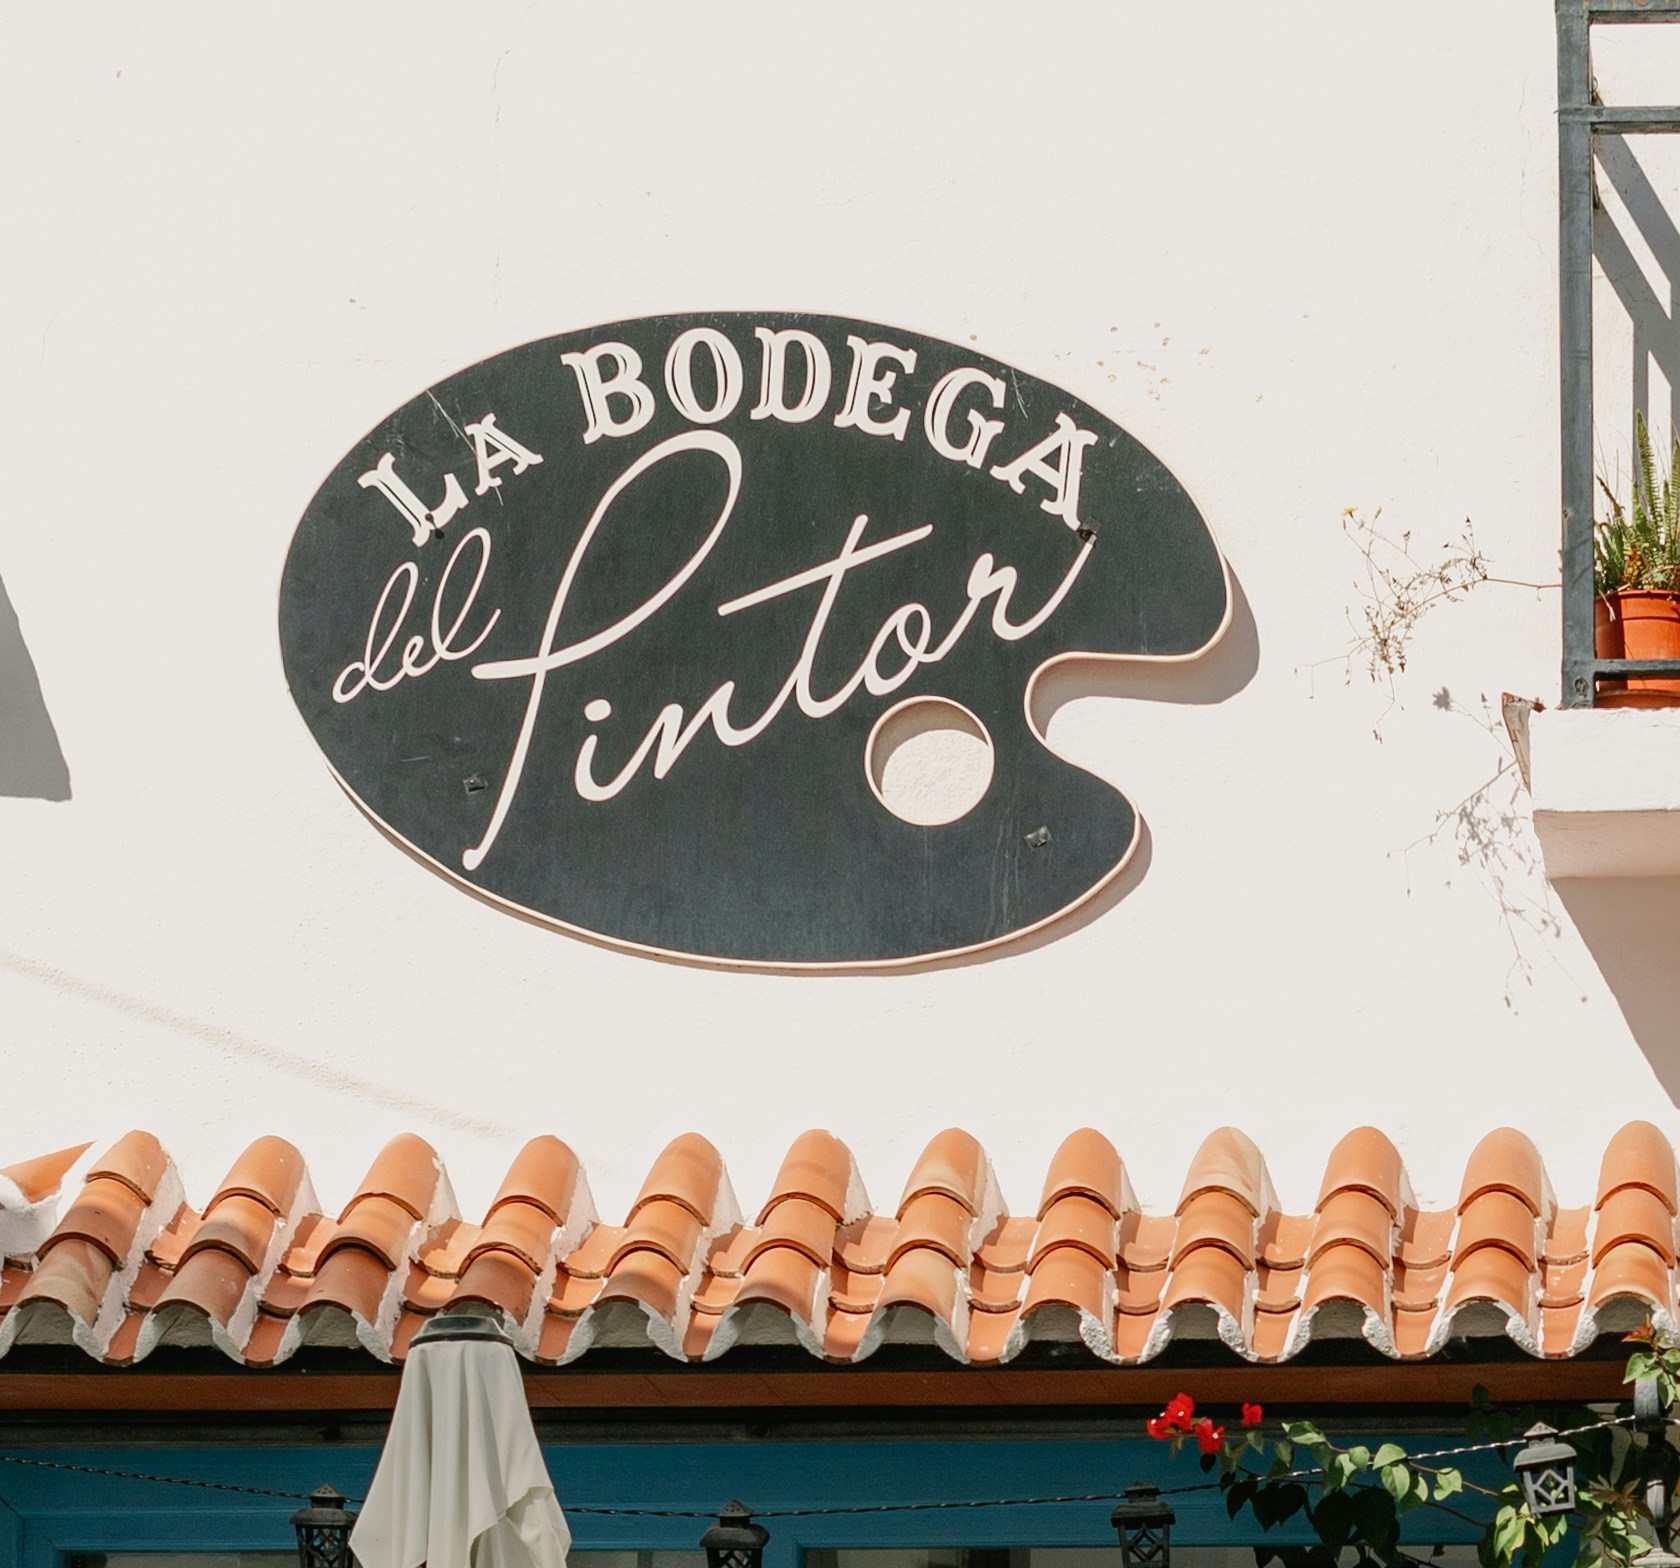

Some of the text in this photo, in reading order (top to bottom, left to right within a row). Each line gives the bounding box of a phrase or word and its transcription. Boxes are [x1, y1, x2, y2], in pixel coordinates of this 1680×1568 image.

[359, 327, 1099, 545] LA BODEGA
[333, 429, 1096, 871] del Pintor
